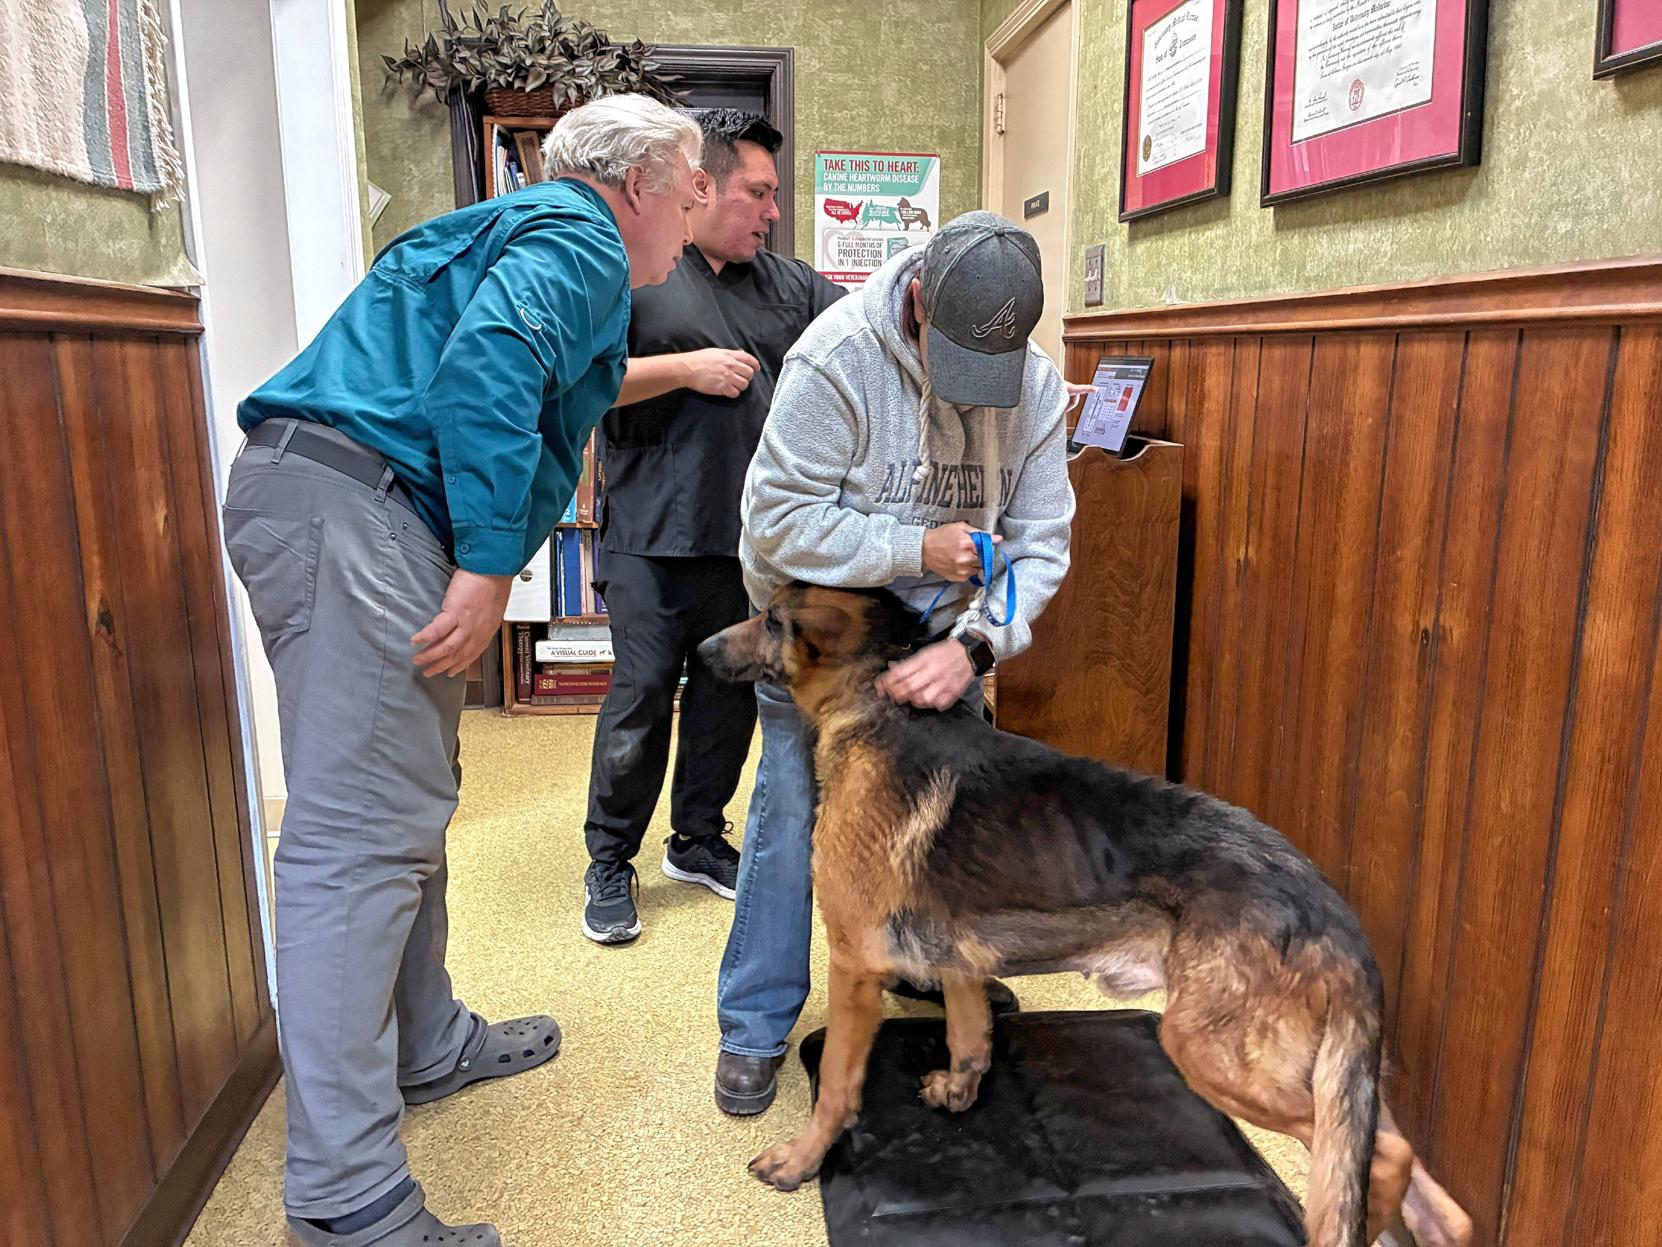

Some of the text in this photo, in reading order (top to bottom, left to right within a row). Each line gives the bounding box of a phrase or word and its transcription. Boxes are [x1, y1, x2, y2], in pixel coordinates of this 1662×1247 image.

[823, 158, 919, 173] TAKE THIS TO HEART:
[823, 172, 919, 183] CANINE HEARTWORM DISEASE
[823, 183, 880, 192] BY THE NUMBERS
[837, 249, 883, 259] PROTECTION
[837, 259, 845, 267] IN
[852, 259, 882, 268] INJECTION
